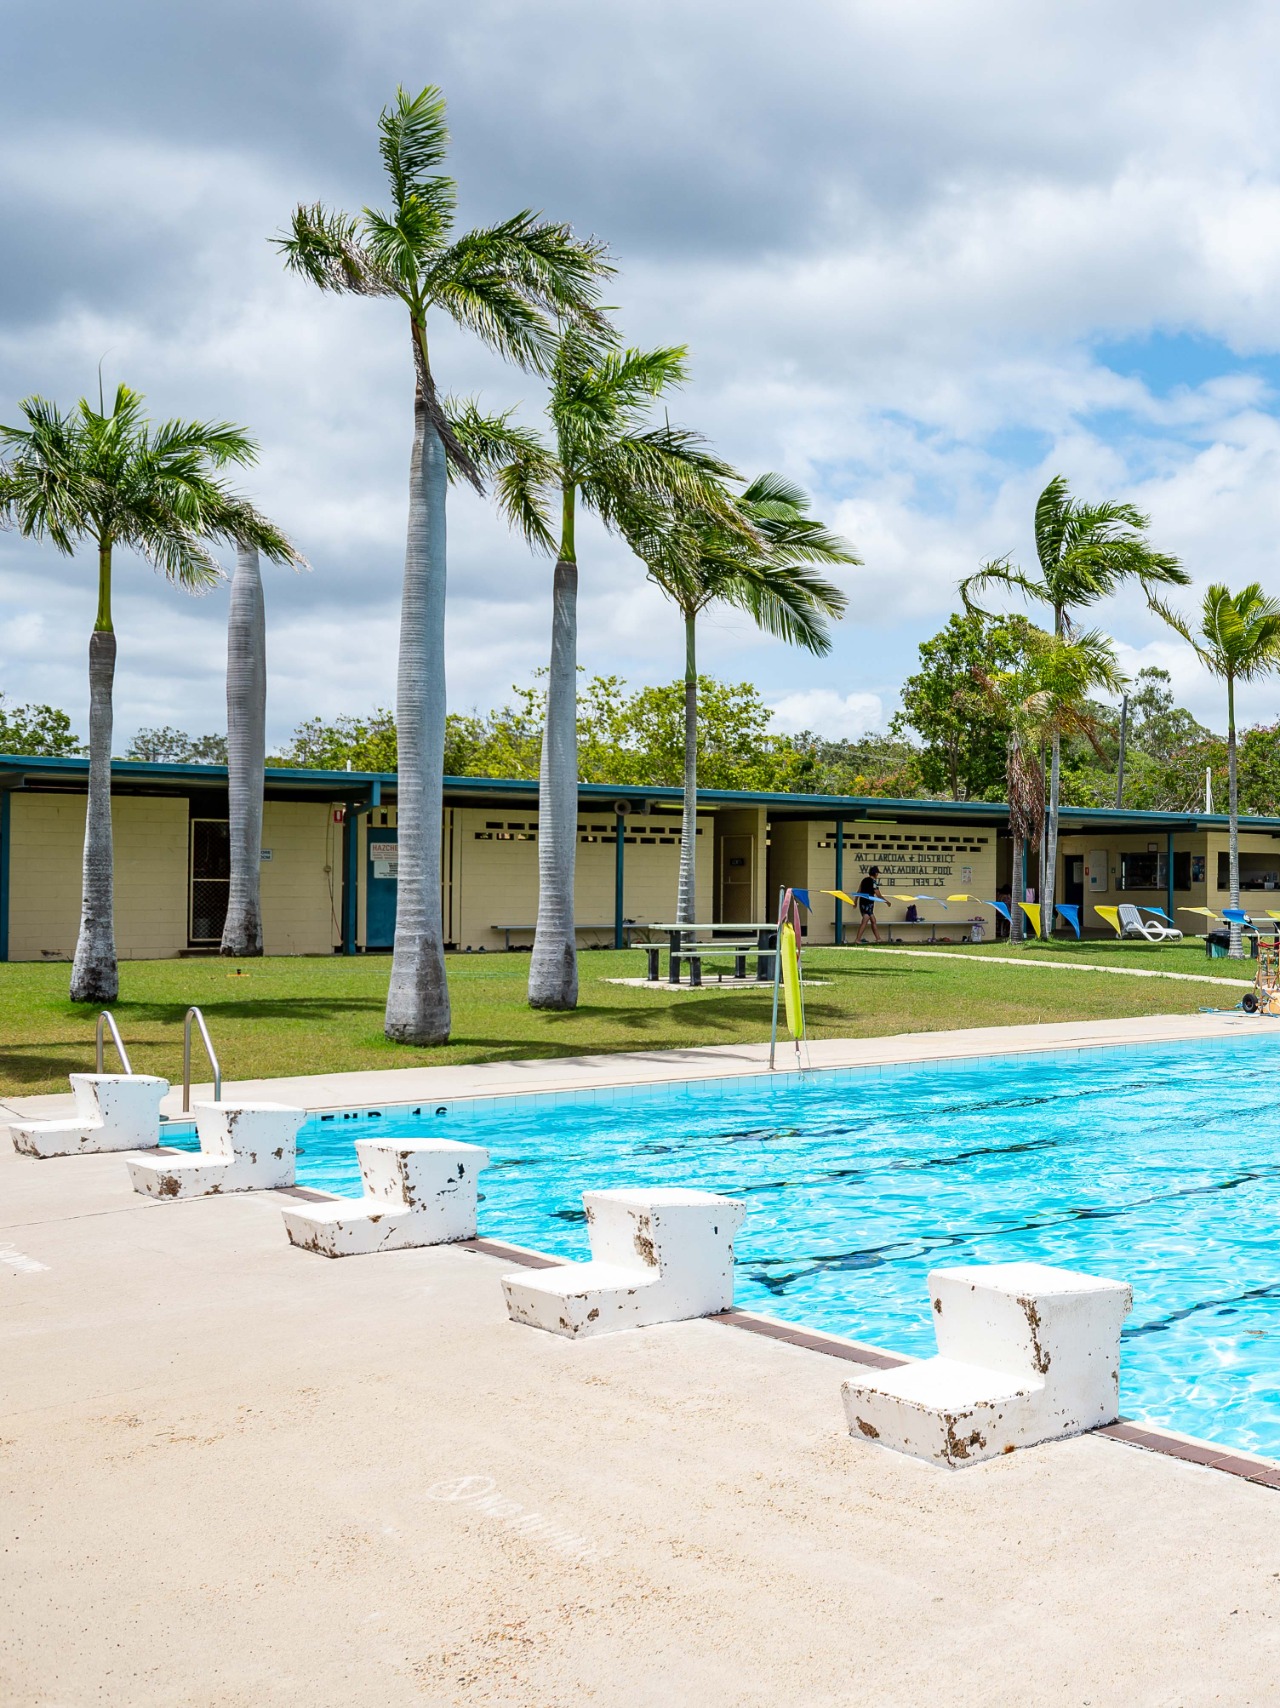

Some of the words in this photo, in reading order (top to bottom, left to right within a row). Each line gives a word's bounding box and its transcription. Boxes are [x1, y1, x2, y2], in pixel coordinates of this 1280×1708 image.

[873, 853, 906, 862] LARCOM
[917, 853, 955, 863] DISTRICT
[883, 865, 928, 875] MEMORIAL
[932, 866, 953, 875] POOL
[887, 878, 896, 886] 18
[913, 878, 930, 886] 1939
[933, 878, 944, 886] 45
